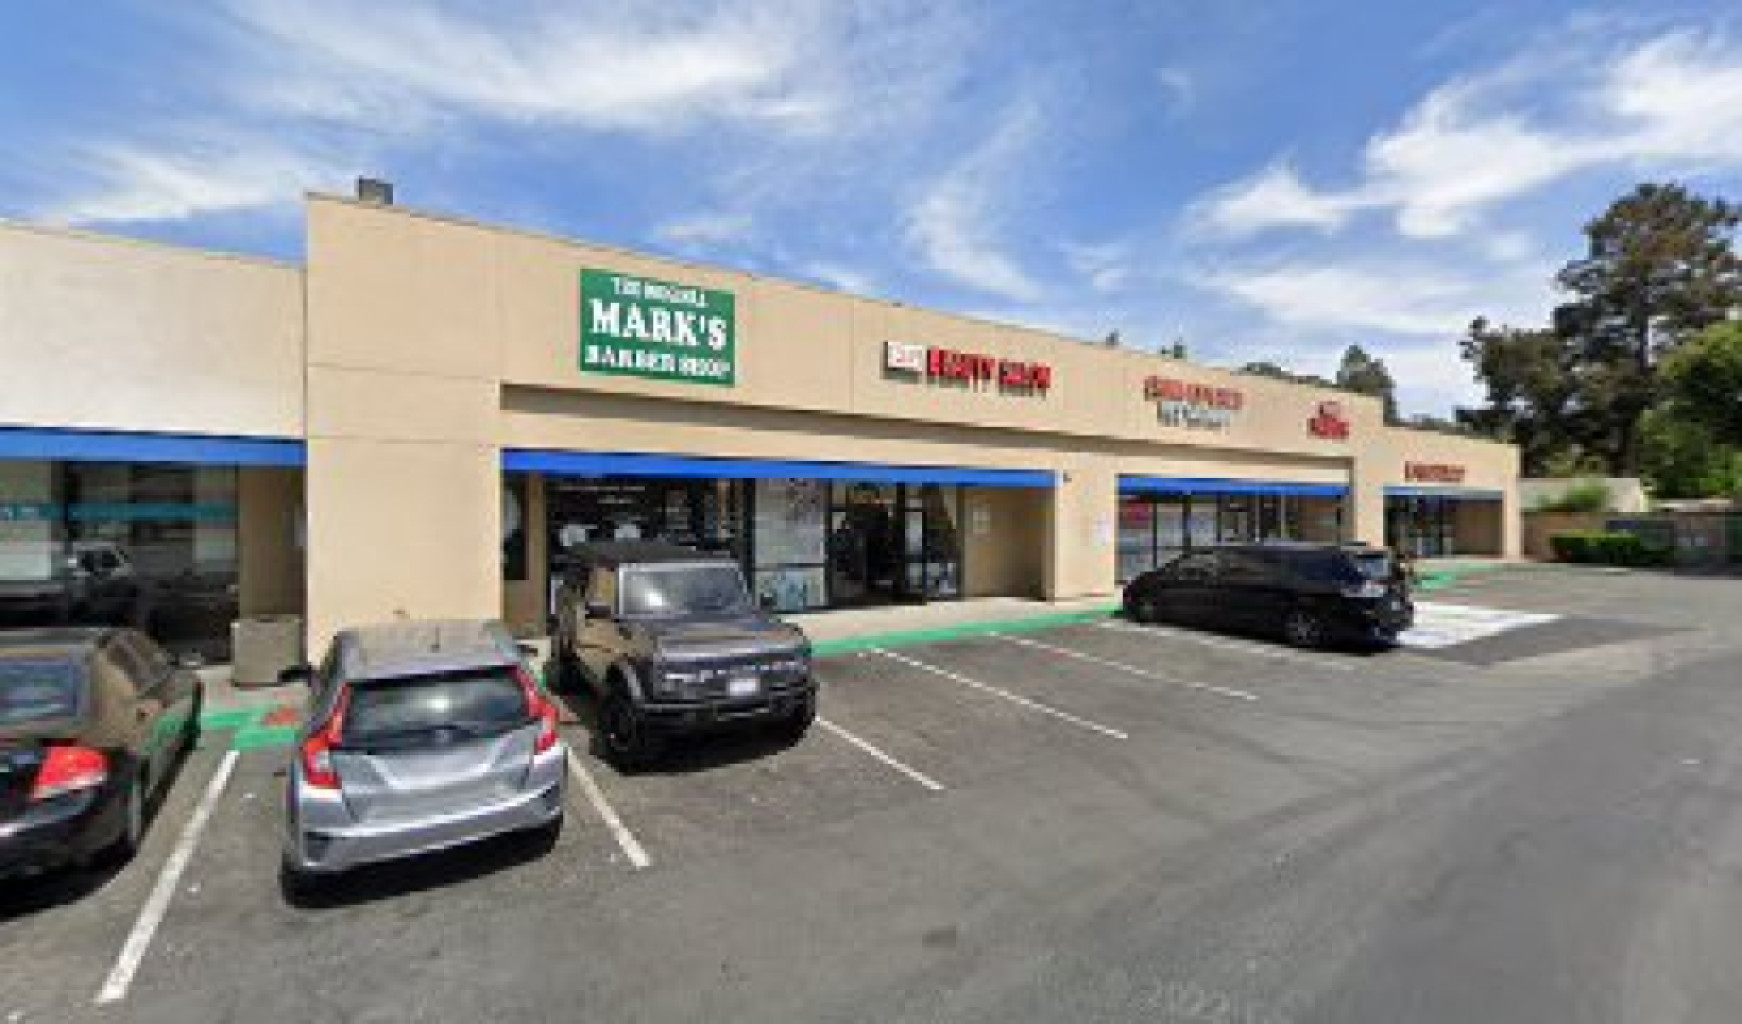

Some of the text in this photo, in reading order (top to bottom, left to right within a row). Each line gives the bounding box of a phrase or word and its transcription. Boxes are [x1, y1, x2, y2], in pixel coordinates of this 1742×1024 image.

[588, 298, 728, 350] MARK'S
[584, 345, 731, 381] BARBER SHOP
[926, 346, 996, 382] BEAUTY
